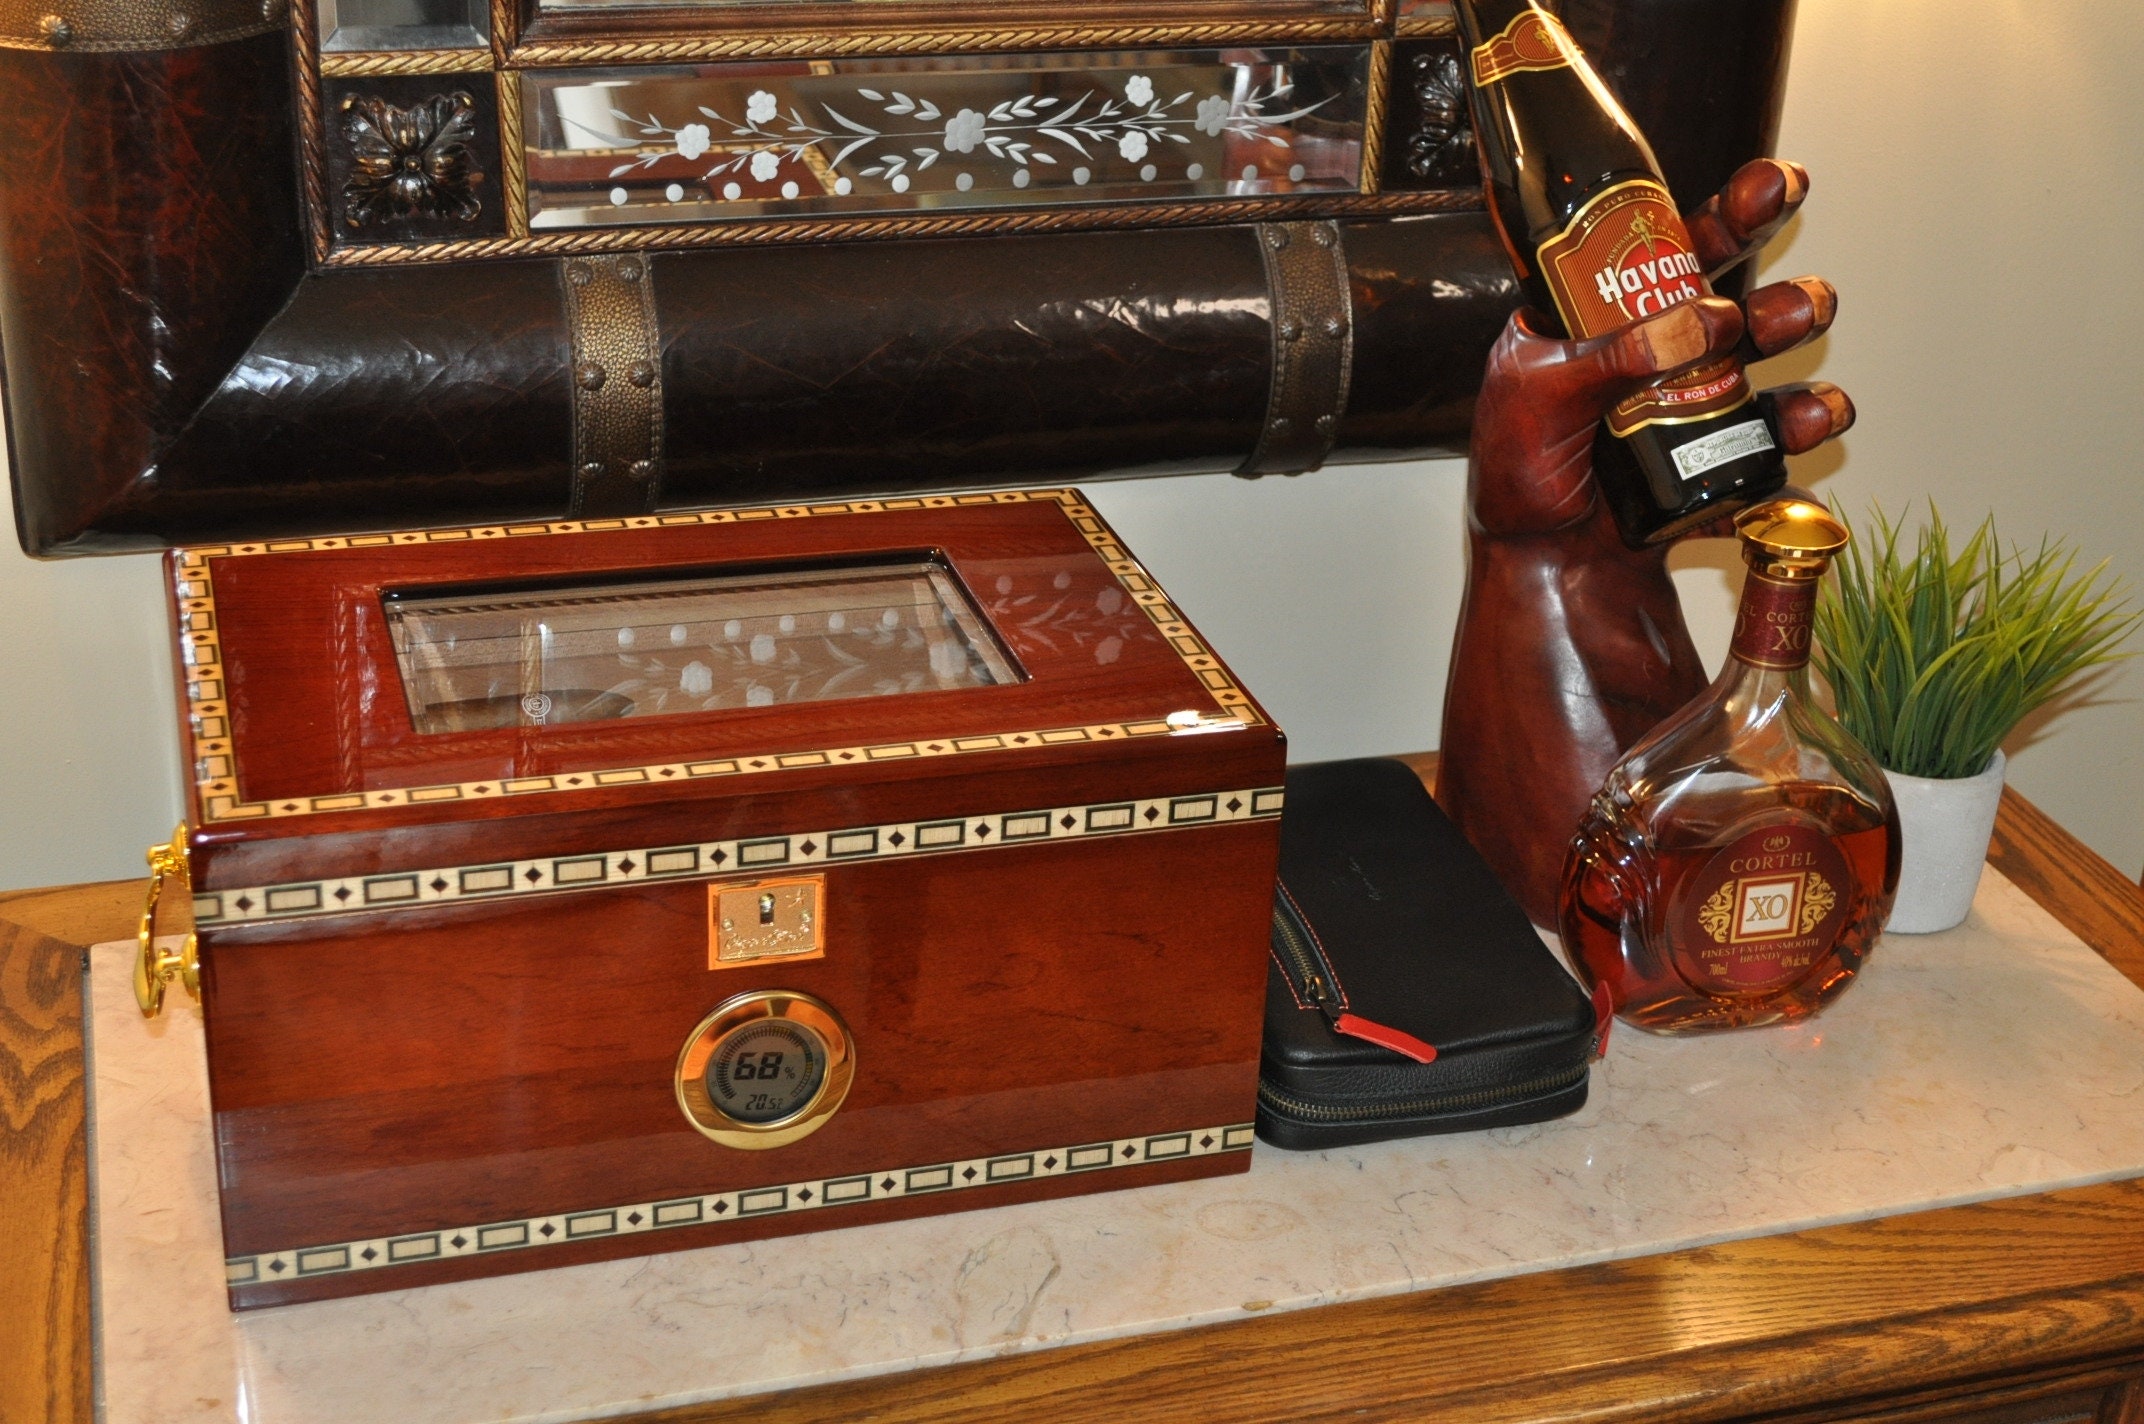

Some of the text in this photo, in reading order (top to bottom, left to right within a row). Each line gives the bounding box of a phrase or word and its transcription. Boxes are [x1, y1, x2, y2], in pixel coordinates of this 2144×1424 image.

[1594, 252, 1701, 304] Havana
[1636, 280, 1698, 318] Club
[1666, 372, 1739, 402] EL RON DE CUBA
[1771, 625, 1809, 651] XO
[1729, 851, 1817, 873] CORTEL
[1745, 894, 1789, 922] XO
[1701, 938, 1819, 959] FINEST EXTRA SMOOTH
[1740, 951, 1782, 963] BRANDY
